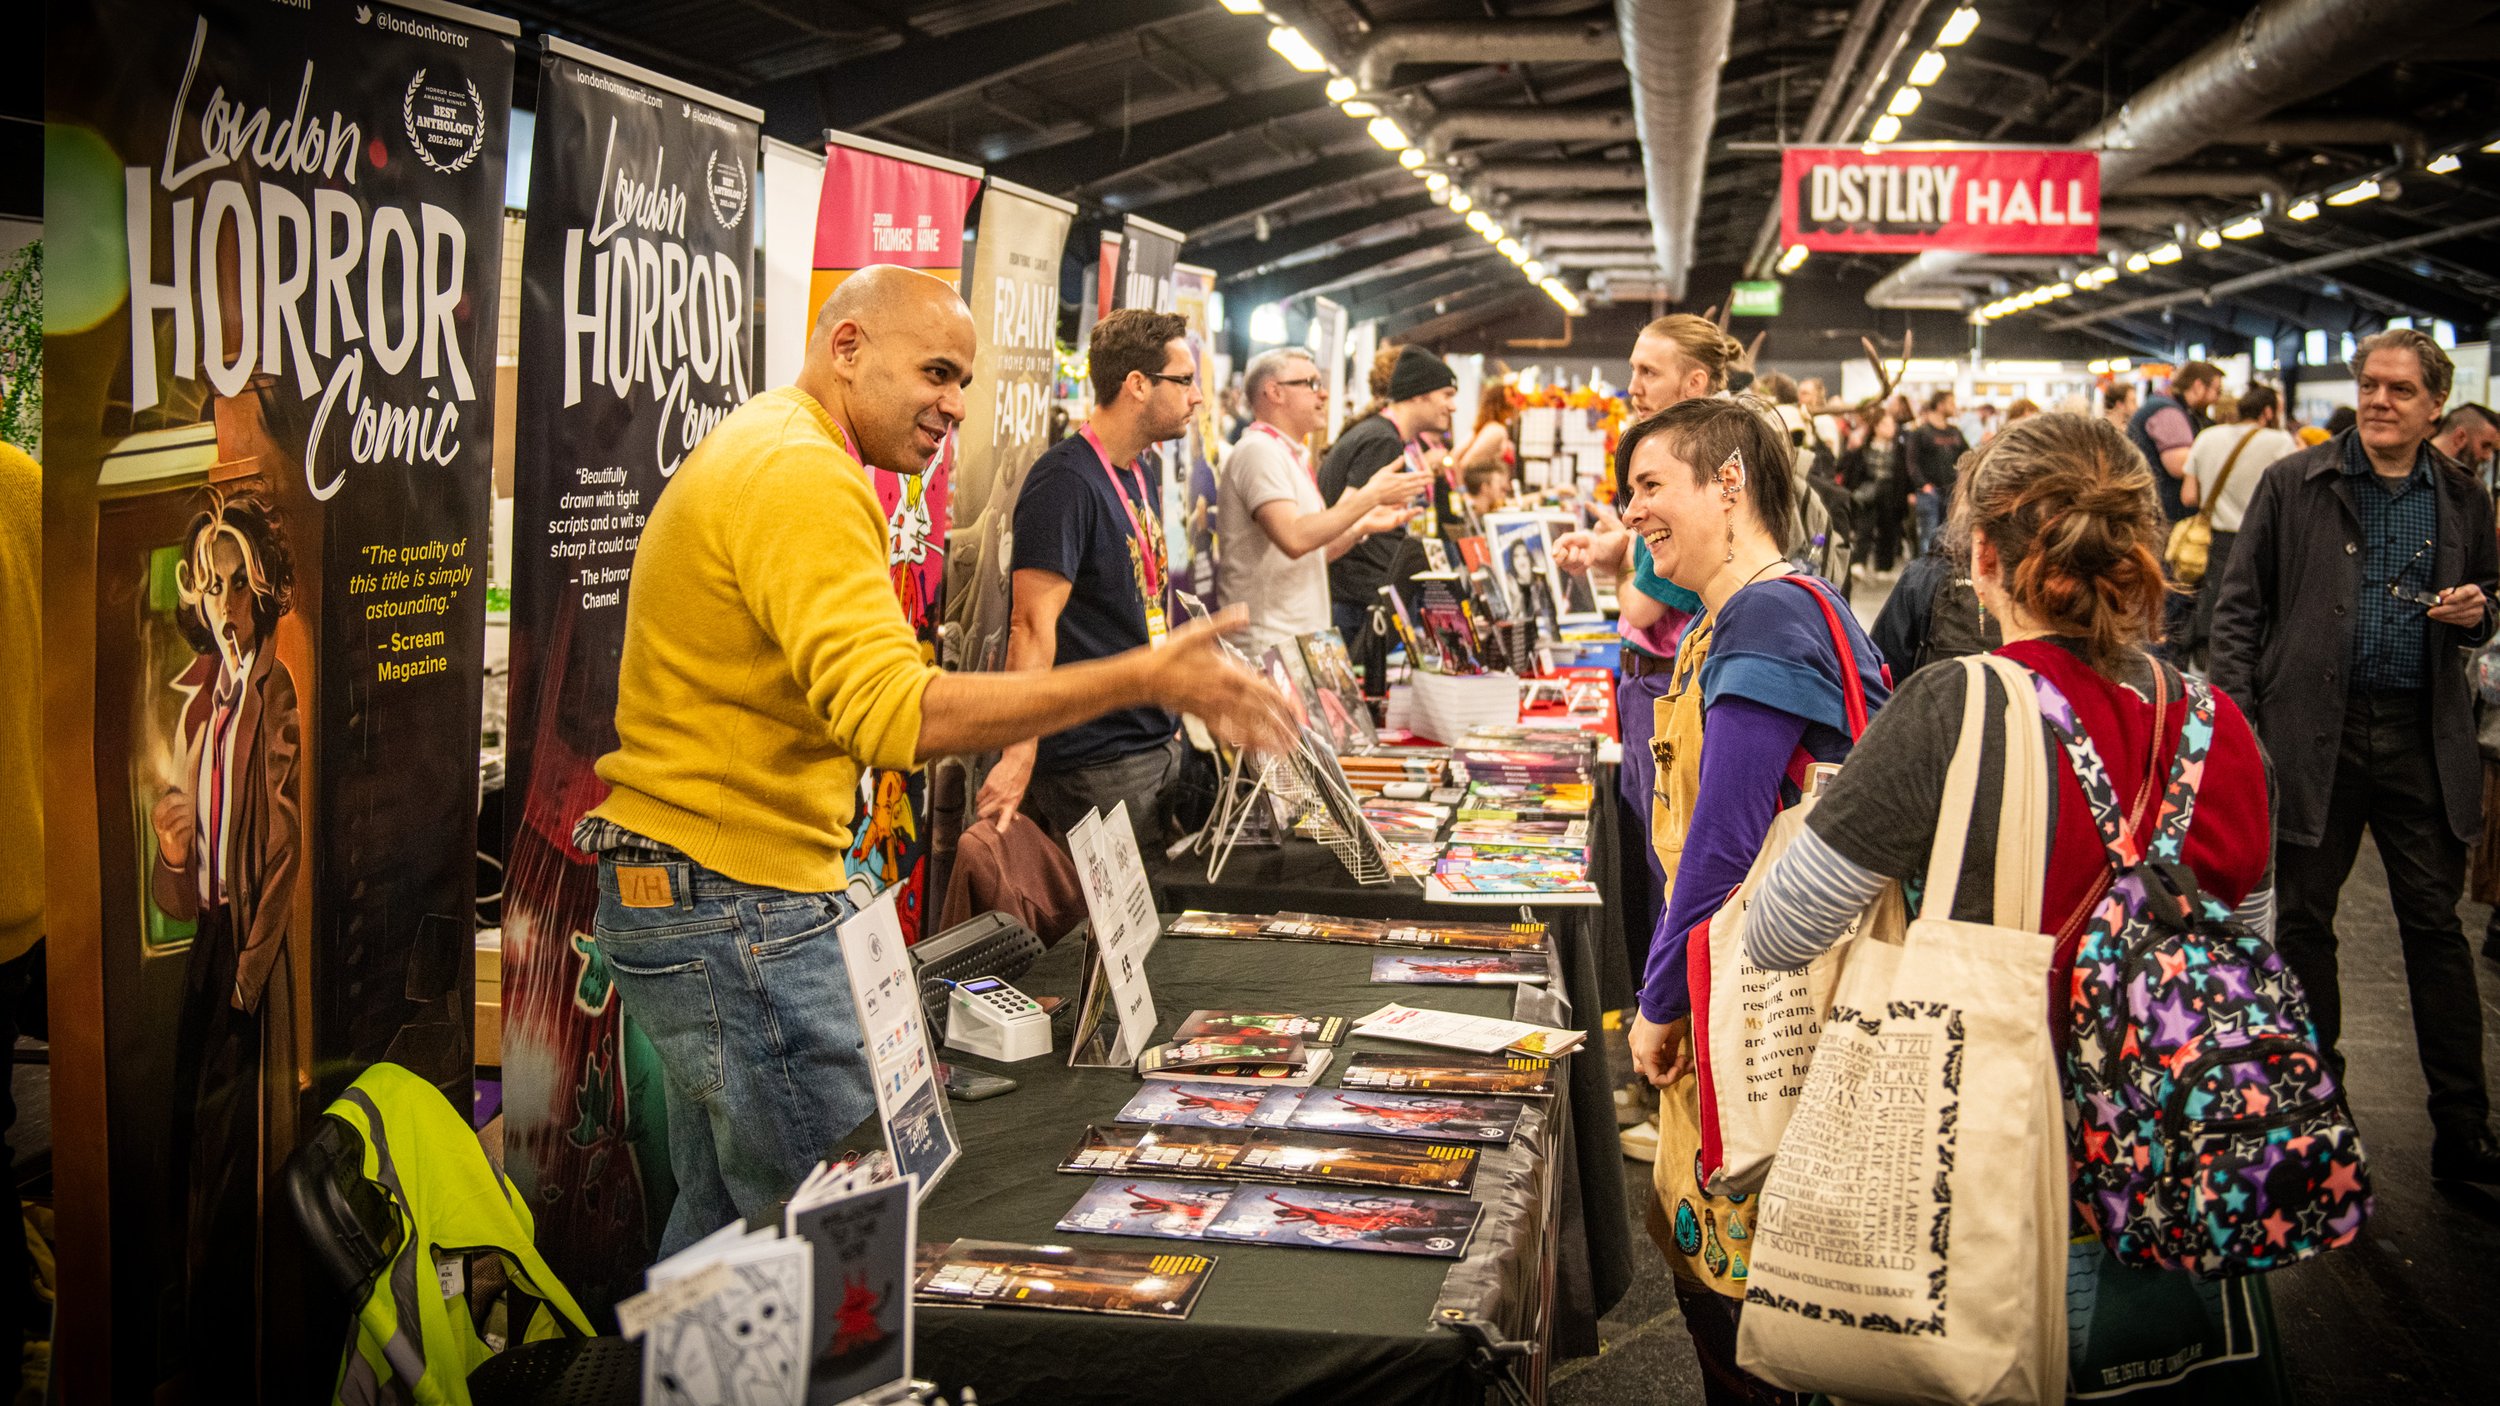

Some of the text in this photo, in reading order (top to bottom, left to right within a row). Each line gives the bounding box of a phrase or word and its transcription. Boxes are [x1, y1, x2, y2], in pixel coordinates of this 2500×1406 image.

[377, 12, 469, 48] @londonhorror
[161, 14, 361, 191] London
[425, 86, 466, 99] HORROR COMIC
[446, 98, 467, 107] WINNER
[433, 104, 457, 120] BEST
[416, 115, 475, 136] ANTHOLOGY
[427, 133, 444, 145] 2012
[448, 137, 463, 148] 2014
[589, 115, 686, 246] London
[1810, 164, 2094, 227] DSTLRY HALL
[872, 227, 913, 252] THOMAS
[126, 166, 476, 413] HORROR
[563, 228, 748, 408] HORROR
[993, 275, 1059, 351] FRANK
[305, 347, 460, 501] Comic
[657, 362, 742, 478] Comi
[993, 379, 1051, 447] FARM
[560, 490, 639, 509] drawn with tight
[548, 513, 646, 536] scripts and a wit so
[401, 540, 449, 567] quality
[452, 538, 467, 557] of
[550, 535, 639, 560] sharp it could cut
[350, 564, 473, 594] this title is simply
[581, 569, 599, 586] The
[601, 567, 630, 584] Horror
[582, 589, 620, 610] Channel
[391, 630, 445, 652] Scream
[378, 655, 447, 683] Magazine
[1790, 987, 1807, 998] on
[1745, 1006, 1816, 1030] My dreams
[1745, 1037, 1766, 1049] are
[1773, 1023, 1803, 1039] wild
[1895, 1039, 1932, 1055] TZU
[1745, 1057, 1754, 1066] a
[1762, 1046, 1804, 1062] woven
[1746, 1067, 1783, 1084] sweet
[1872, 1070, 1929, 1087] BLAKE
[1748, 1091, 1768, 1102] the
[1763, 1203, 1782, 1229] M
[1862, 1175, 1881, 1253] COLLINS
[1903, 1188, 1920, 1256] LARSEN
[1770, 1235, 1811, 1258] SCOTT
[1813, 1247, 1917, 1272] FITZGERALD
[1864, 1284, 1916, 1299] LIBRARY
